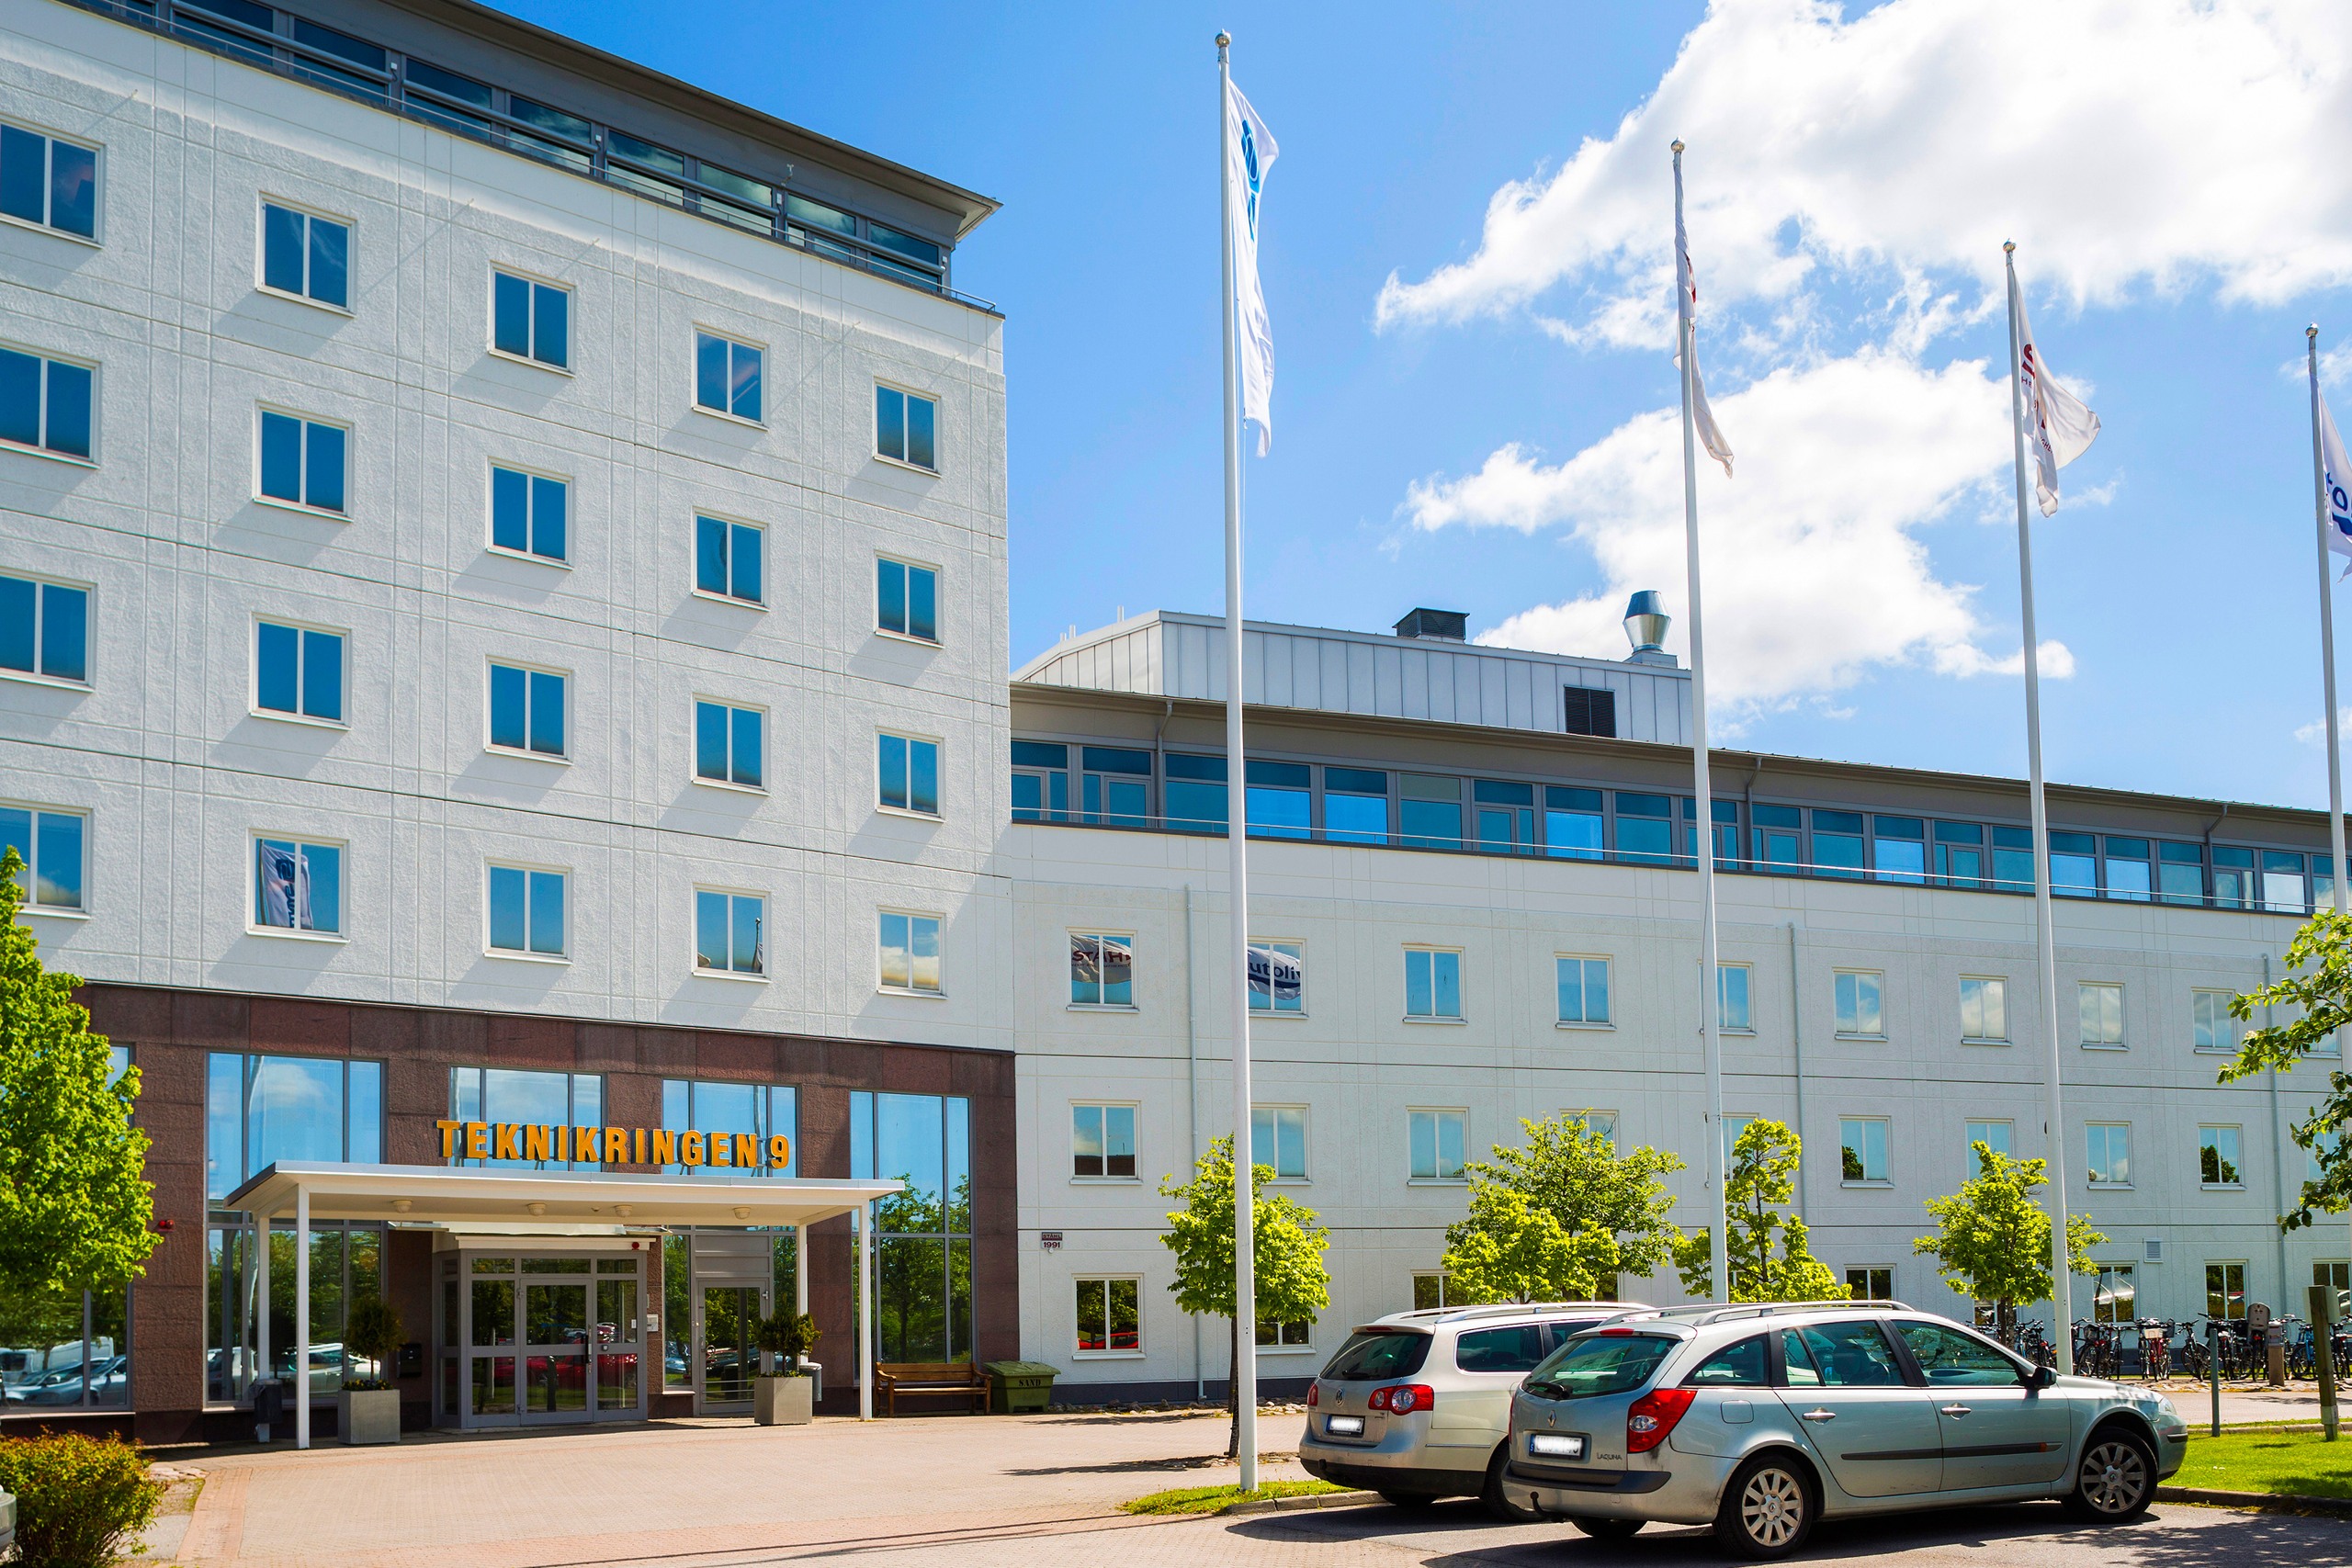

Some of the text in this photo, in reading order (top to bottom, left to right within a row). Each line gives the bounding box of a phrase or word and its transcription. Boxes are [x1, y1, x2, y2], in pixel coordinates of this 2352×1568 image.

[1248, 962, 1301, 981] utoliv
[435, 1120, 791, 1170] TEKNIKRINGEN 9
